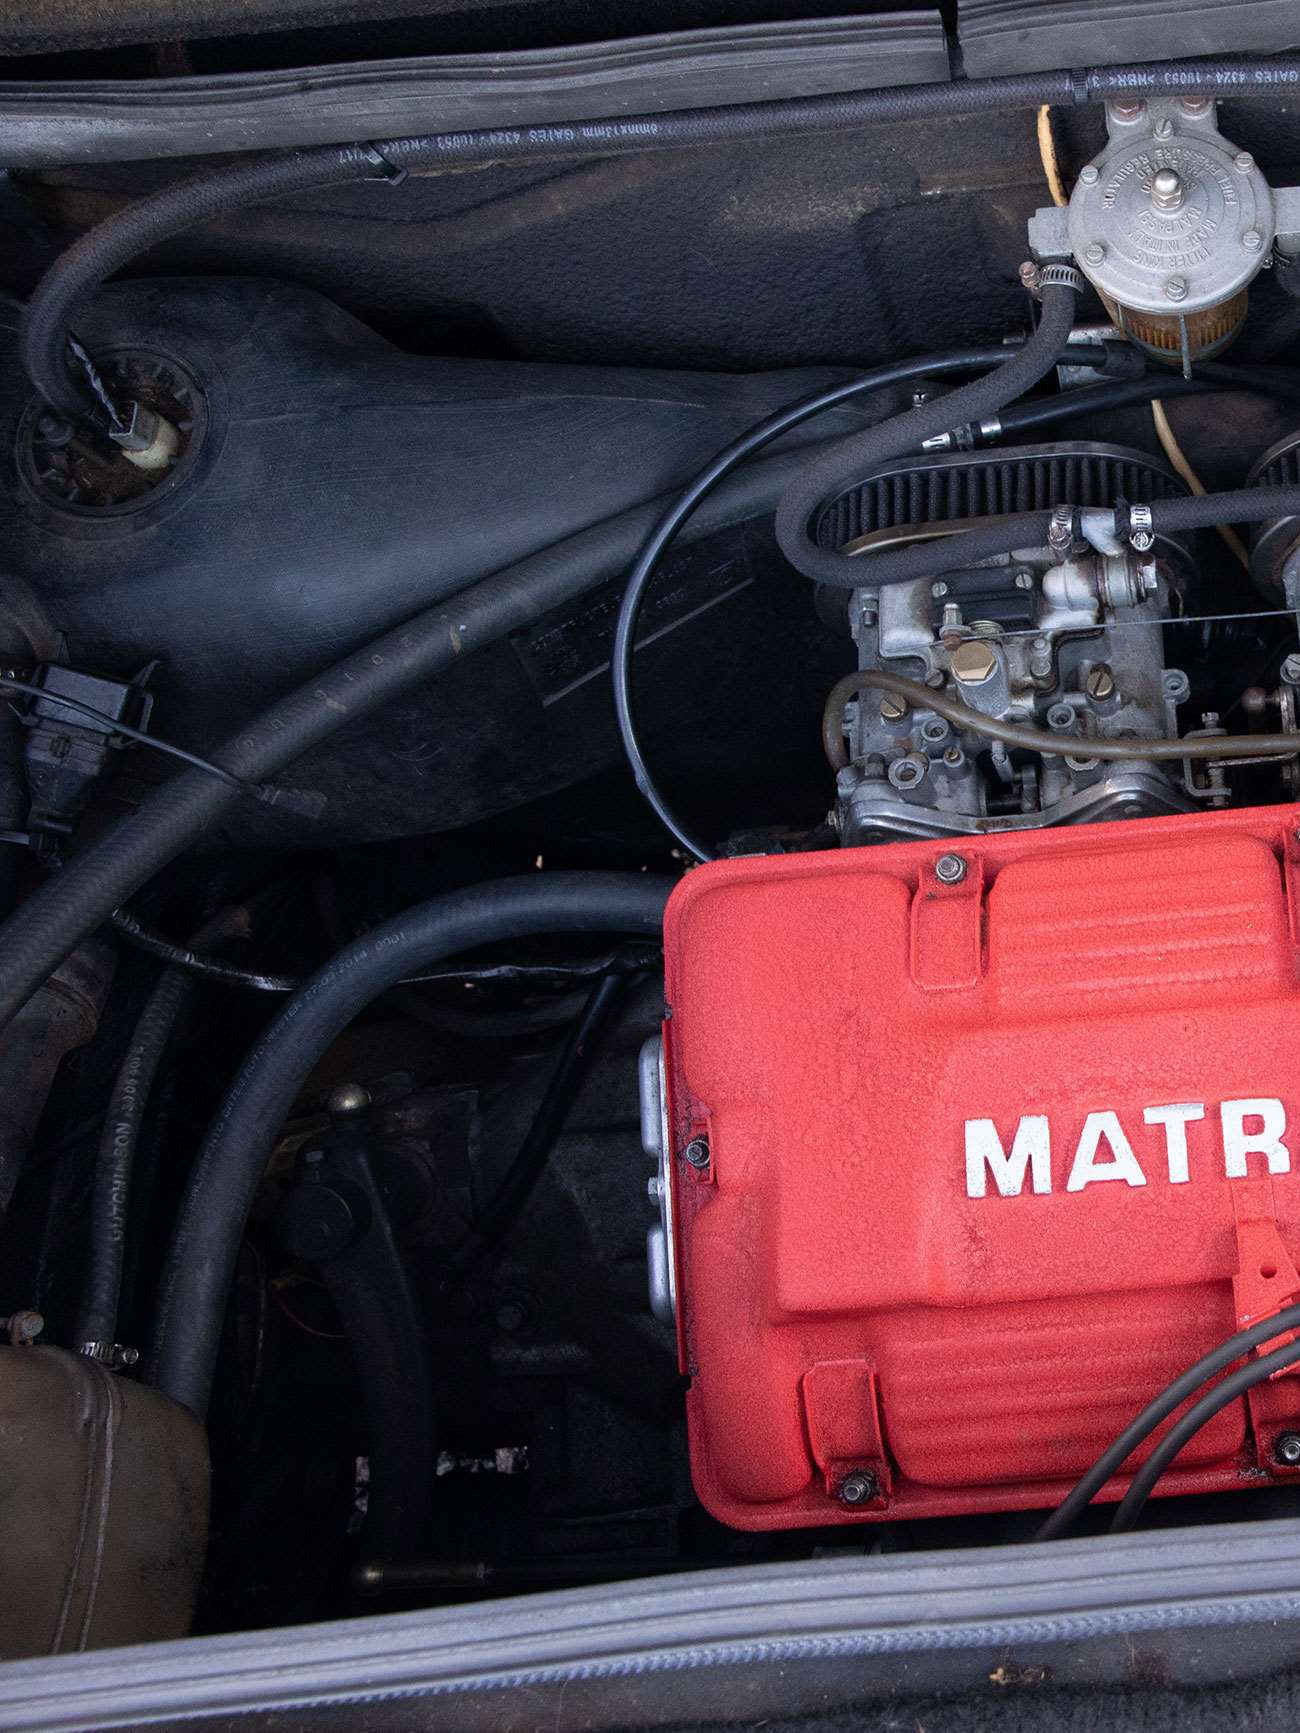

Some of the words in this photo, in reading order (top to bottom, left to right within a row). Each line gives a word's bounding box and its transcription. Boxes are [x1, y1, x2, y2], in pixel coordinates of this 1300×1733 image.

[1215, 70, 1246, 84] 4324
[1255, 70, 1298, 83] GATES
[529, 127, 574, 143] GATES
[1154, 148, 1219, 175] PRESSURE
[1102, 152, 1151, 209] REGULATOR
[1218, 177, 1237, 206] FUEL
[1137, 207, 1201, 234] MALPASSI
[1128, 228, 1163, 247] ITALY
[1186, 219, 1217, 244] MADE
[1167, 239, 1181, 248] IN
[1132, 253, 1163, 269] KING
[1168, 247, 1212, 269] FILTER
